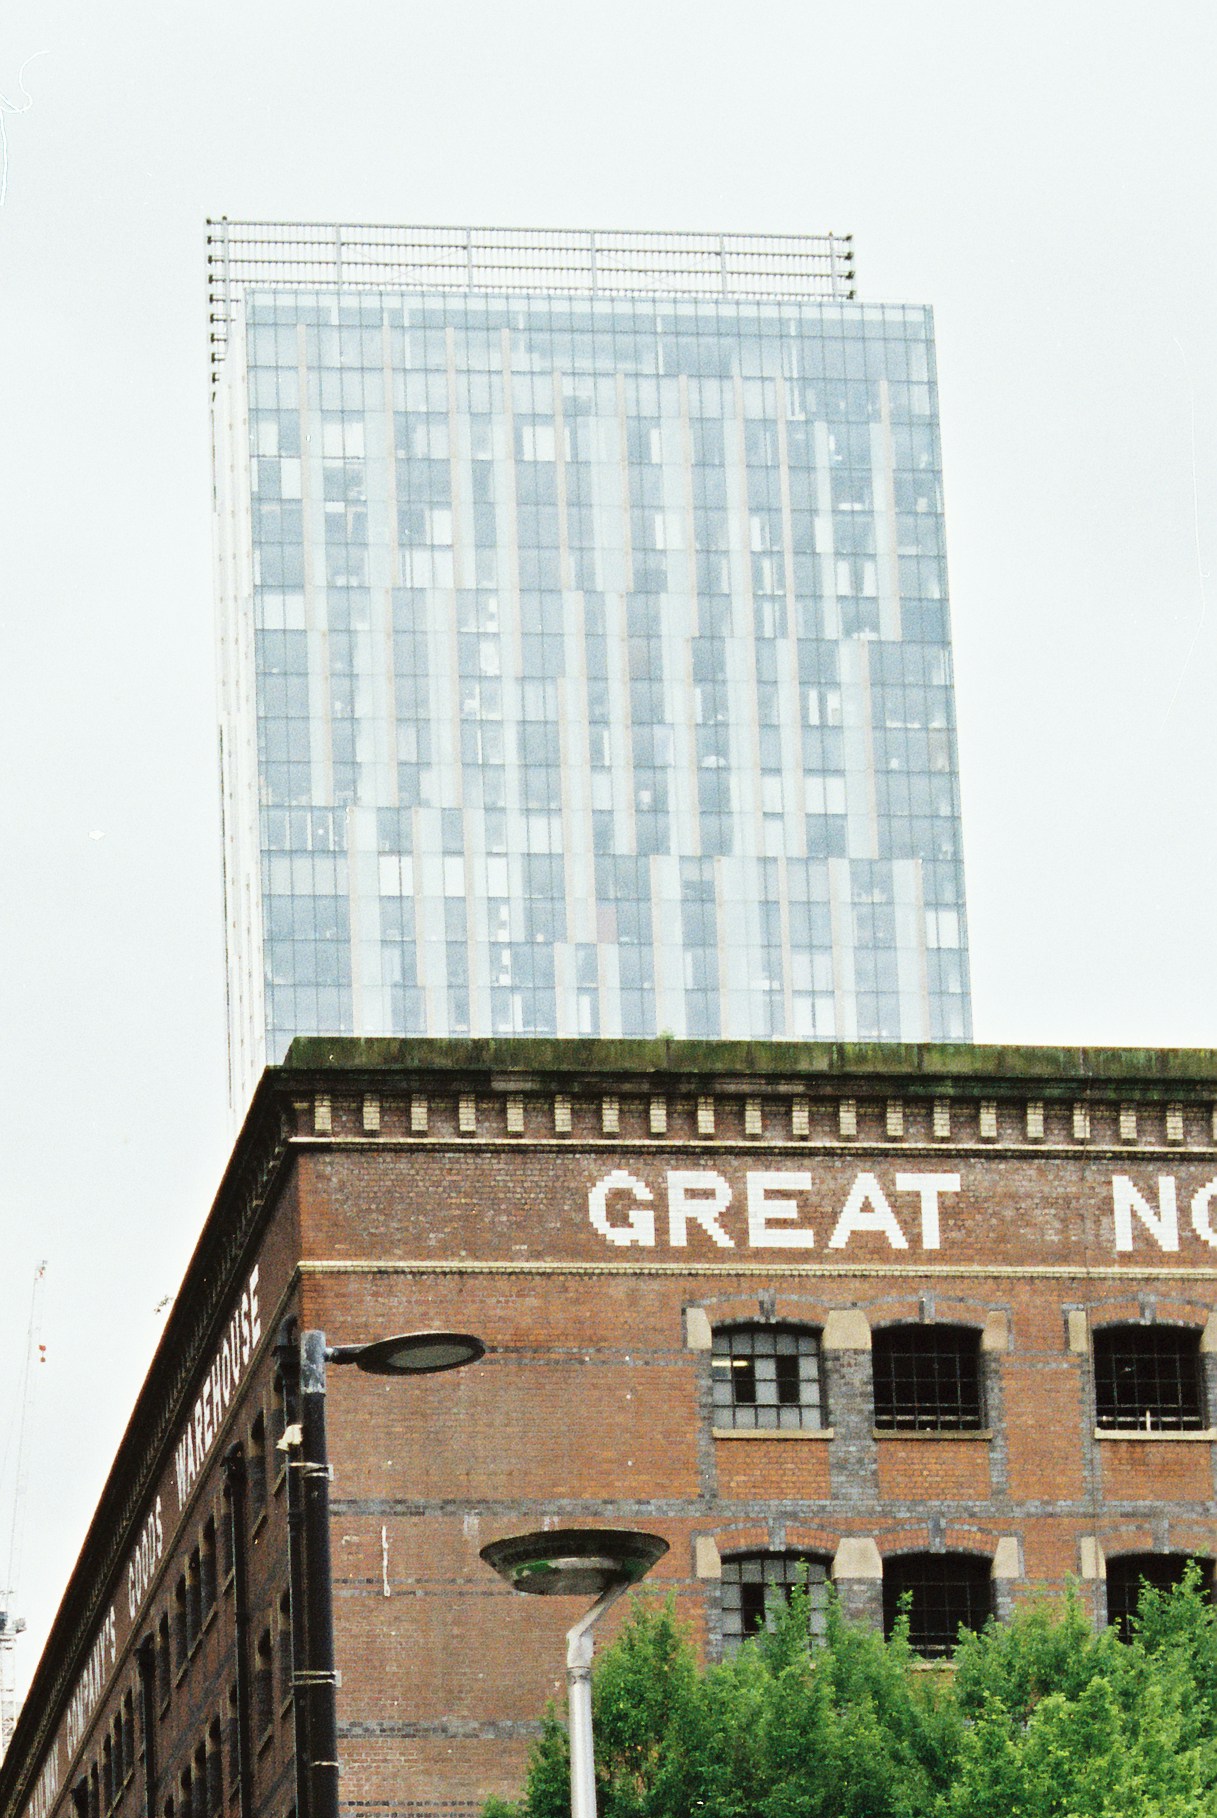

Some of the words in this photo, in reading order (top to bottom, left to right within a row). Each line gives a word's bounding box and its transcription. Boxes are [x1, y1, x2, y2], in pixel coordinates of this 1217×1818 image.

[587, 1168, 962, 1250] GREAT
[128, 1495, 163, 1621] GOODS
[175, 1263, 261, 1512] WAREHOUSE
